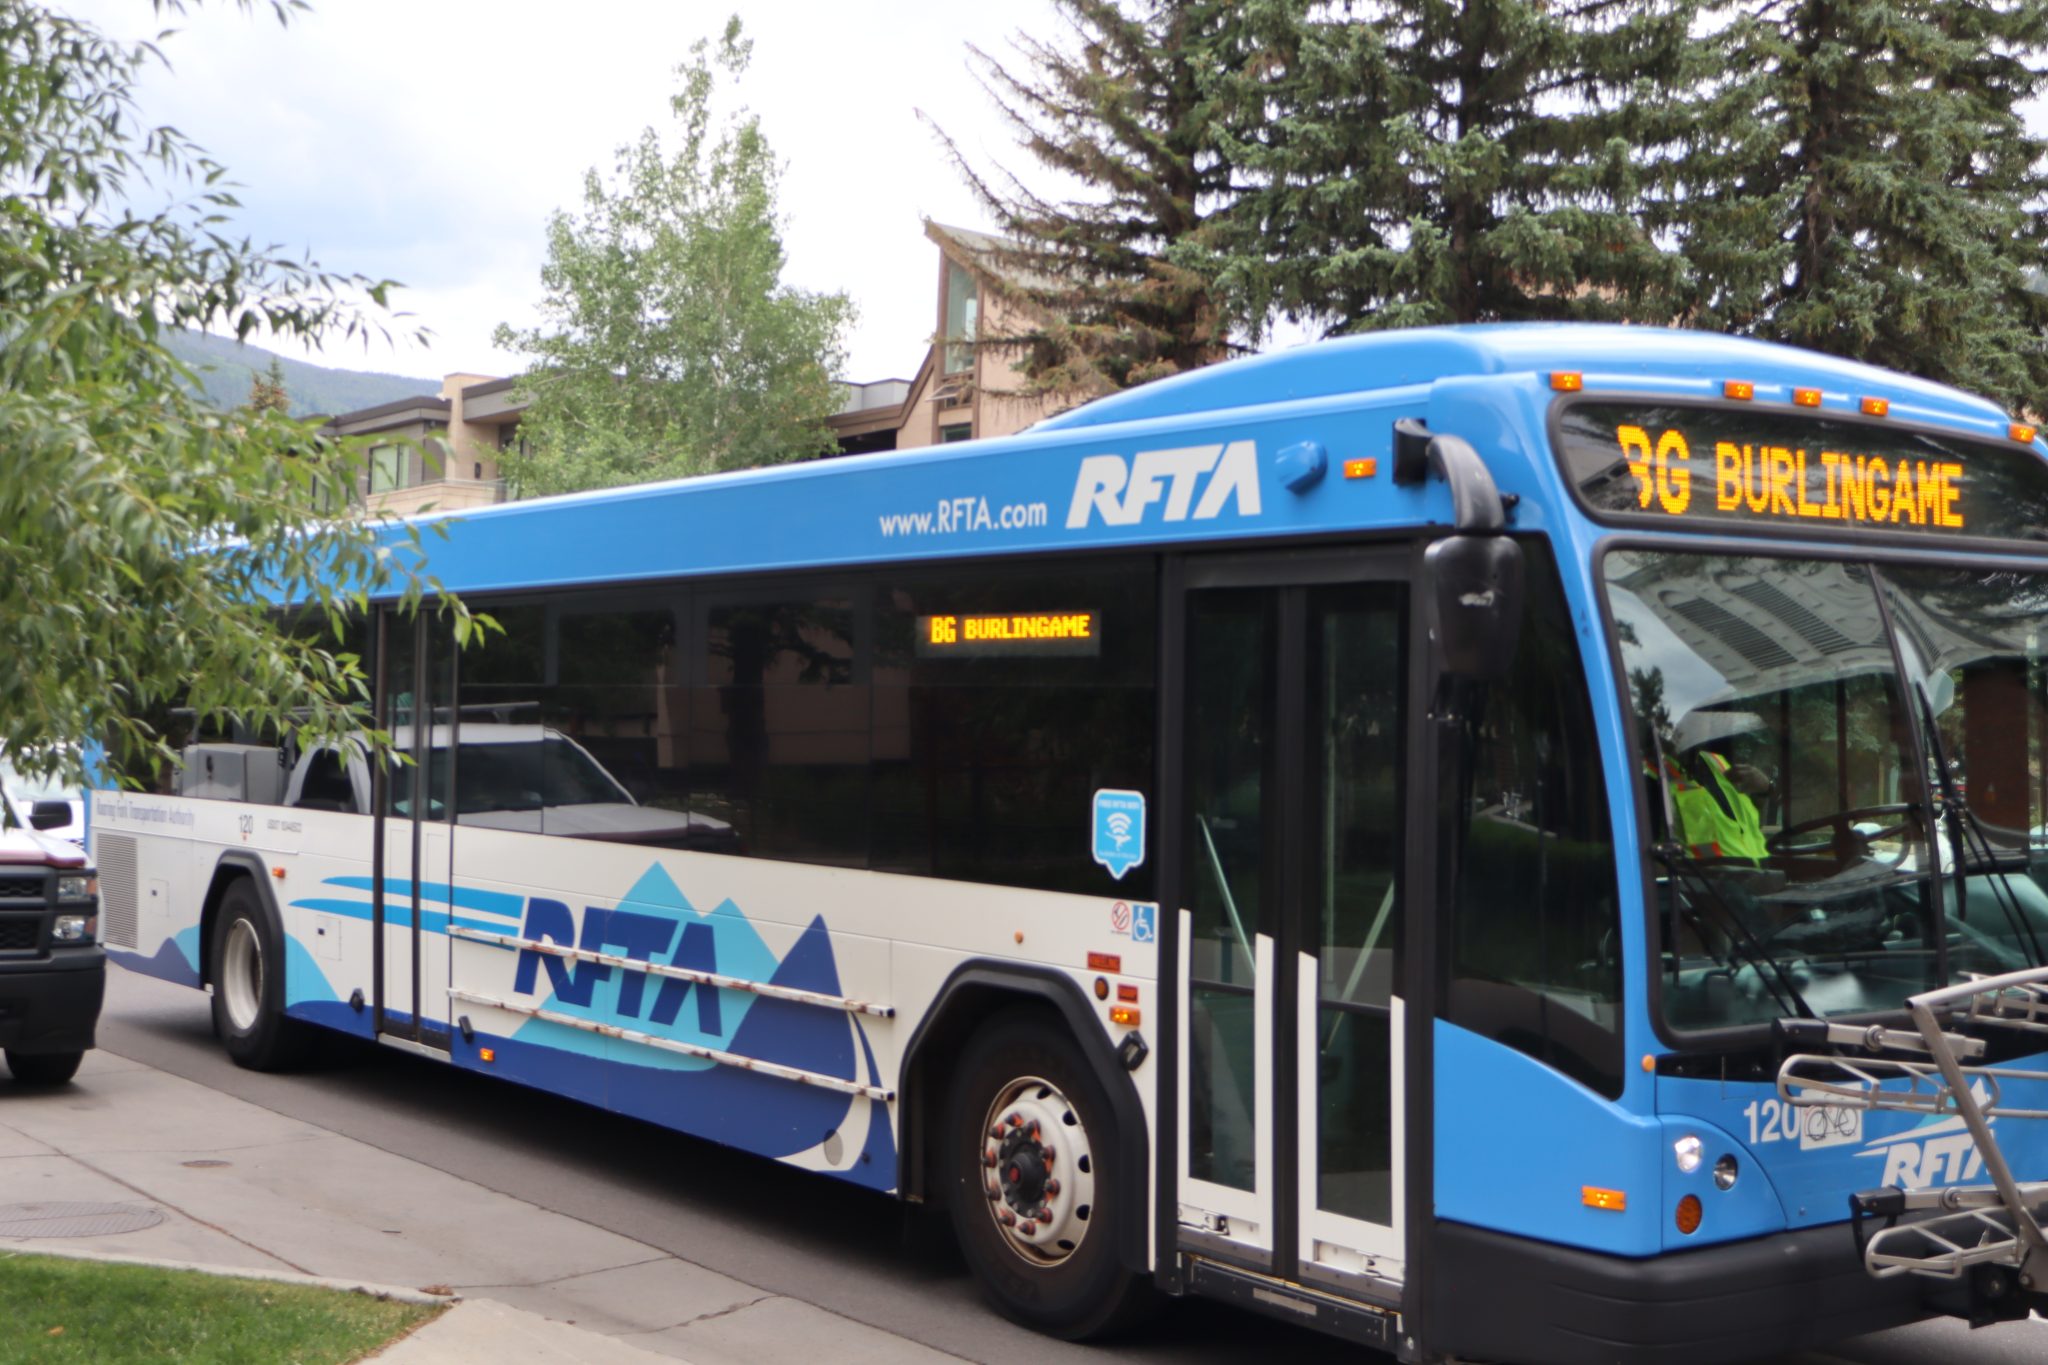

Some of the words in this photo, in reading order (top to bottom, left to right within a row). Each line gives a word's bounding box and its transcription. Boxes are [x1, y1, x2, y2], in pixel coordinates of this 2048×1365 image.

[1065, 439, 1262, 529] RFTA
[1715, 441, 1964, 528] BURLINGAME
[879, 496, 1047, 537] www.RFTA.com
[931, 616, 957, 643] BG
[964, 615, 1090, 640] BURLINGAME
[238, 814, 253, 834] 120
[513, 897, 723, 1037] RFTA
[1744, 1099, 1800, 1145] 120
